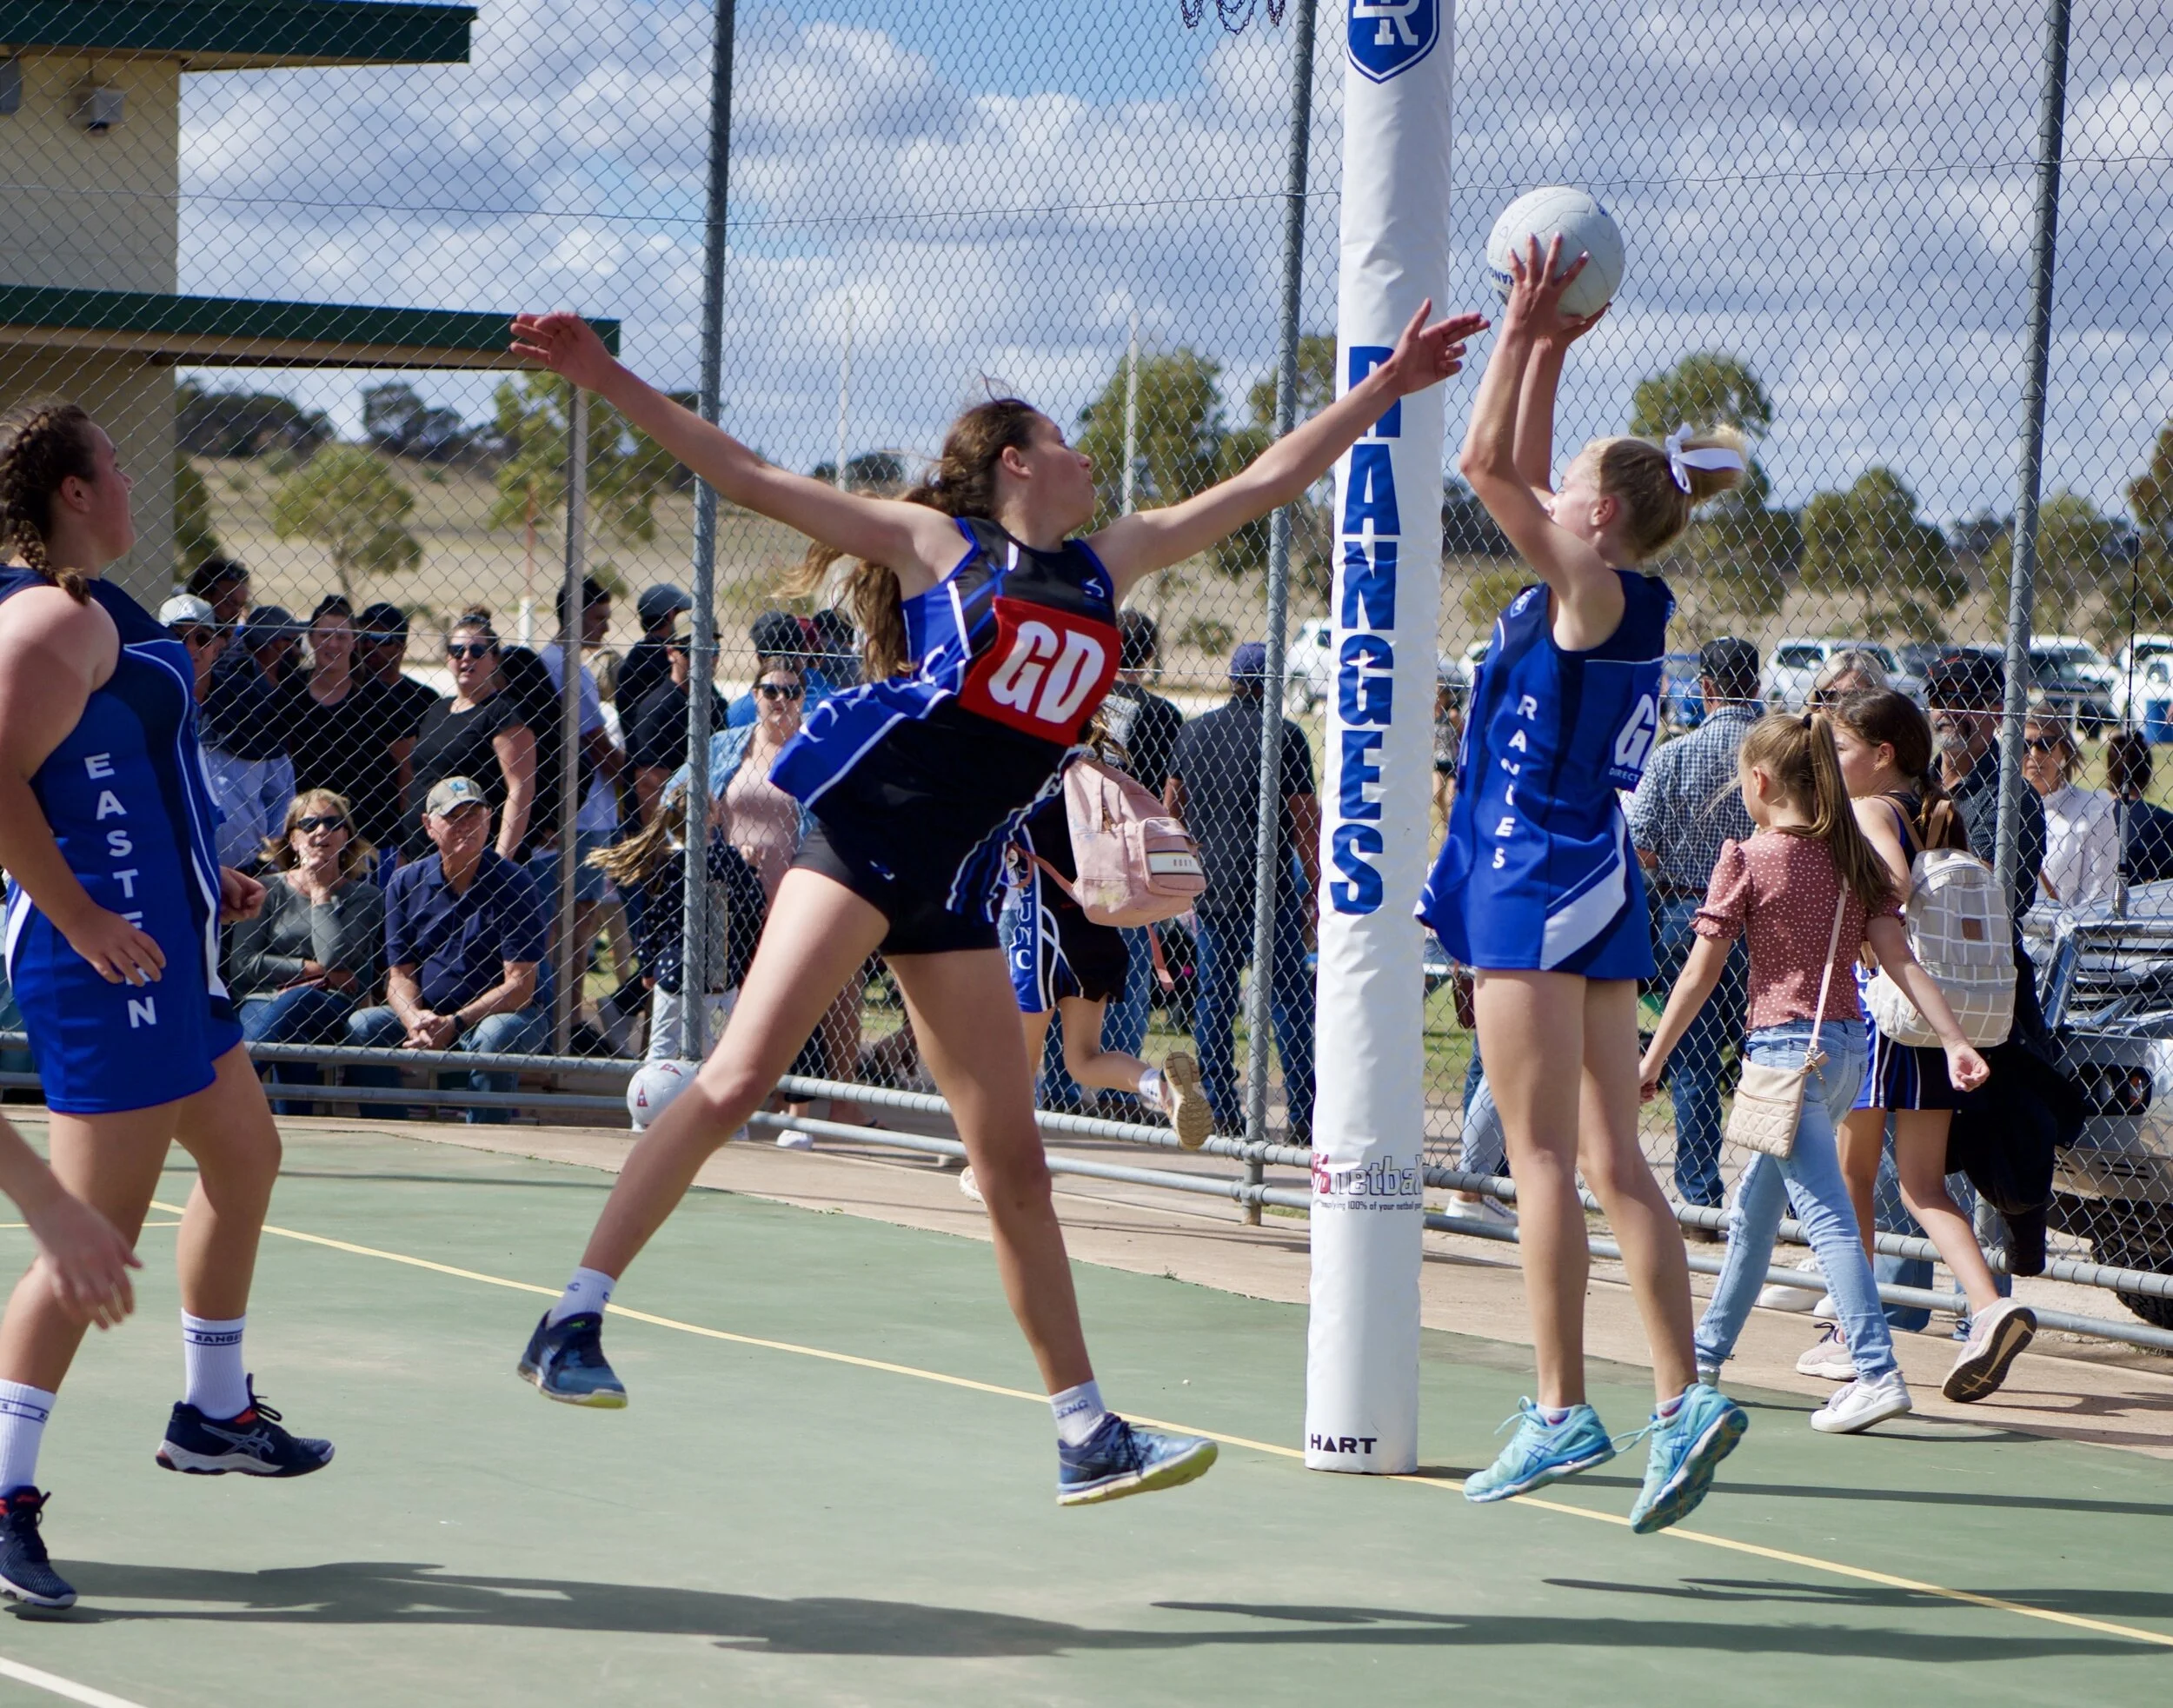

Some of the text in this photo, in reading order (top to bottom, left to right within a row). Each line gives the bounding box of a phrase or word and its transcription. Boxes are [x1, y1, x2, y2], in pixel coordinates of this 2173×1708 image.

[988, 621, 1106, 724] GD
[1348, 1200, 1368, 1211] 100%
[1370, 1201, 1378, 1211] of
[1379, 1203, 1394, 1213] your
[1311, 1433, 1377, 1454] HART
